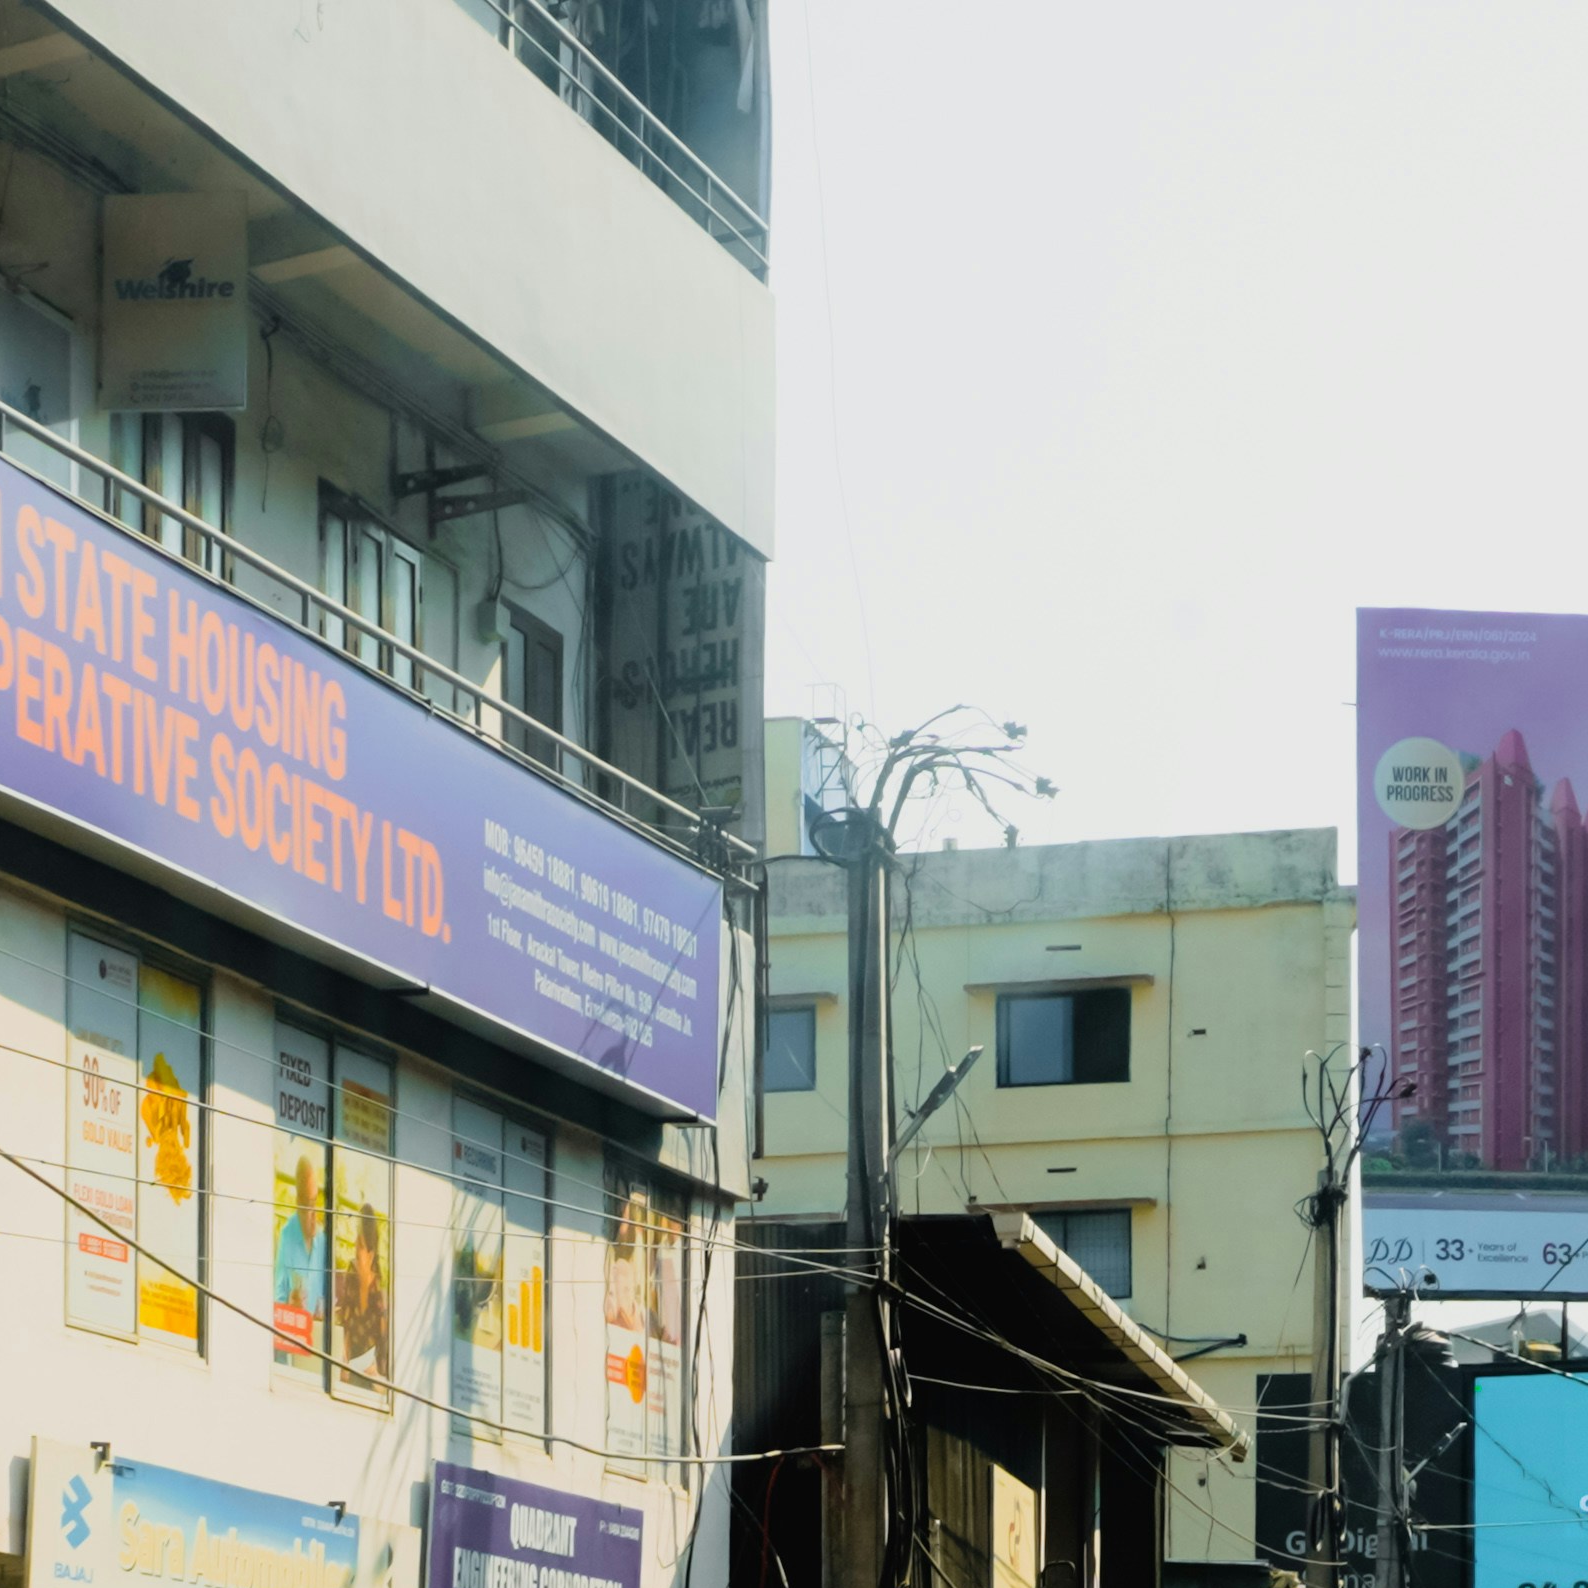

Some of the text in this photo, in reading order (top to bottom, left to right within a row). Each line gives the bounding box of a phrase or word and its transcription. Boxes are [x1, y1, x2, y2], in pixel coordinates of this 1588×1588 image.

[16, 503, 157, 683] STATE
[168, 588, 347, 780] HOUSING
[1386, 783, 1454, 804] PROGRESS
[1391, 766, 1448, 786] WORK IN
[210, 731, 370, 906] SOCIETY
[380, 826, 452, 944] LTD.
[484, 817, 511, 859] MOB:
[279, 1050, 312, 1089] FIXED
[279, 1090, 326, 1133] DEPOSIT
[1477, 1253, 1529, 1264] Excellence
[119, 1500, 185, 1583] Sara
[510, 1502, 578, 1558] QUADRANT
